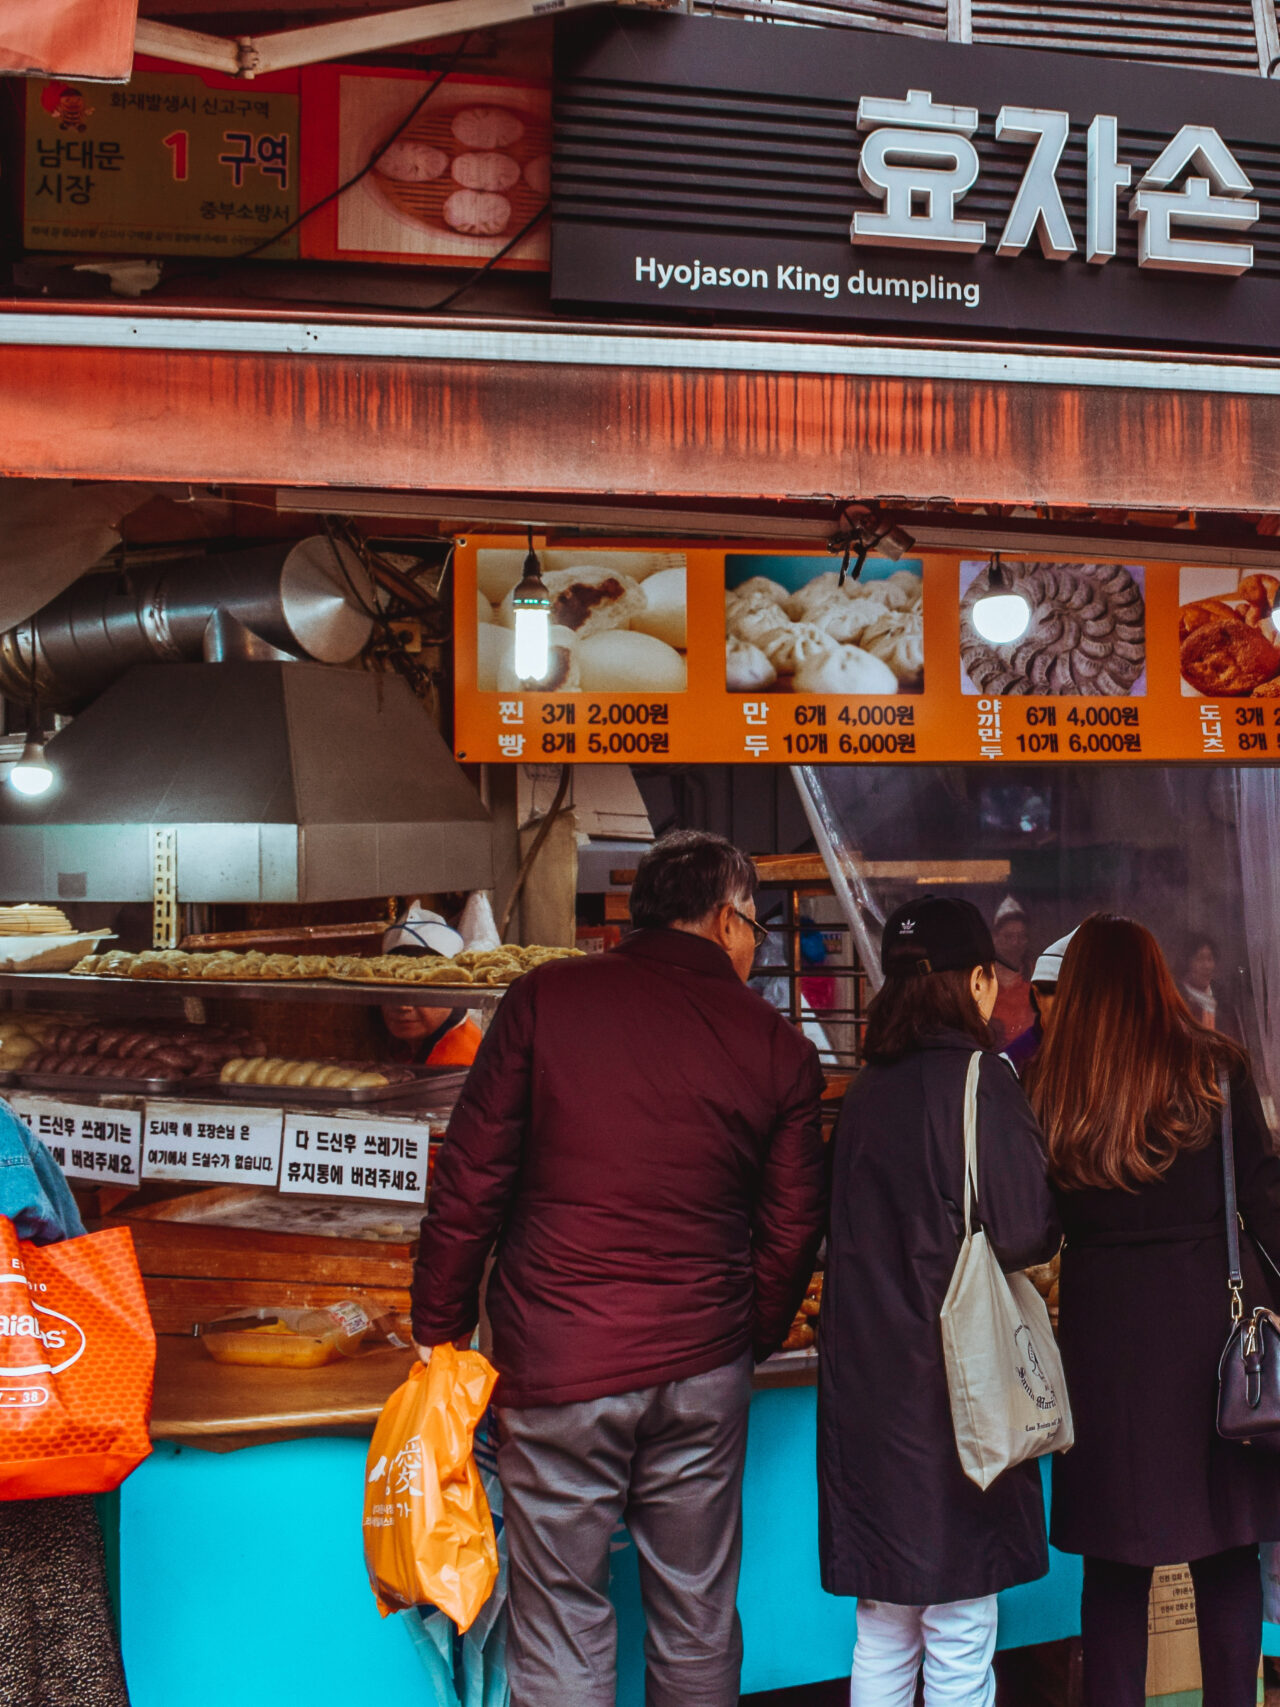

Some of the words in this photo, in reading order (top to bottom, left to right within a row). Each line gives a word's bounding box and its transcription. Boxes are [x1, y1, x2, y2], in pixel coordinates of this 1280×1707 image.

[109, 91, 197, 114] 화재발생시
[201, 96, 270, 119] 신고구역
[36, 138, 125, 172] 남대문
[162, 130, 189, 182] 1
[218, 130, 290, 191] 구역
[35, 173, 95, 205] 시장
[850, 89, 1261, 276] 효자손
[635, 256, 769, 290] Hyojason
[776, 264, 842, 298] King
[847, 270, 982, 308] dumpling
[497, 701, 526, 757] 찐빵
[541, 703, 576, 726] 3개
[587, 703, 670, 727] 2,000원
[794, 704, 828, 727] 6개
[837, 704, 916, 728] 4,000원
[977, 699, 1004, 760] 야끼만두
[1026, 706, 1057, 727] 6개
[1066, 707, 1140, 728] 4,000원
[1199, 705, 1225, 754] 도너츠
[1235, 706, 1265, 727] 3개
[541, 732, 576, 755] 8개
[587, 732, 670, 756] 5,000원
[743, 702, 770, 758] 만두
[783, 732, 828, 756] 10개
[838, 733, 917, 756] 6,000원
[1016, 733, 1059, 754] 10개
[1068, 733, 1142, 754] 6,000원
[1238, 732, 1268, 752] 8개
[39, 1114, 75, 1137] 드신후
[82, 1120, 131, 1144] 쓰레기는
[150, 1120, 178, 1137] 도시락
[183, 1122, 192, 1137] 에
[197, 1122, 235, 1140] 포장손님
[241, 1126, 250, 1141] 은
[296, 1130, 310, 1150] 다
[317, 1131, 357, 1153] 드신후
[364, 1134, 418, 1160] 쓰레기는
[71, 1149, 135, 1175] 버려주세요.
[148, 1149, 187, 1167] 여기에서
[192, 1151, 230, 1169] 드실수가
[235, 1154, 274, 1172] 없습니다.
[288, 1161, 344, 1186] 휴지통에
[351, 1165, 421, 1193] 버려주세요.
